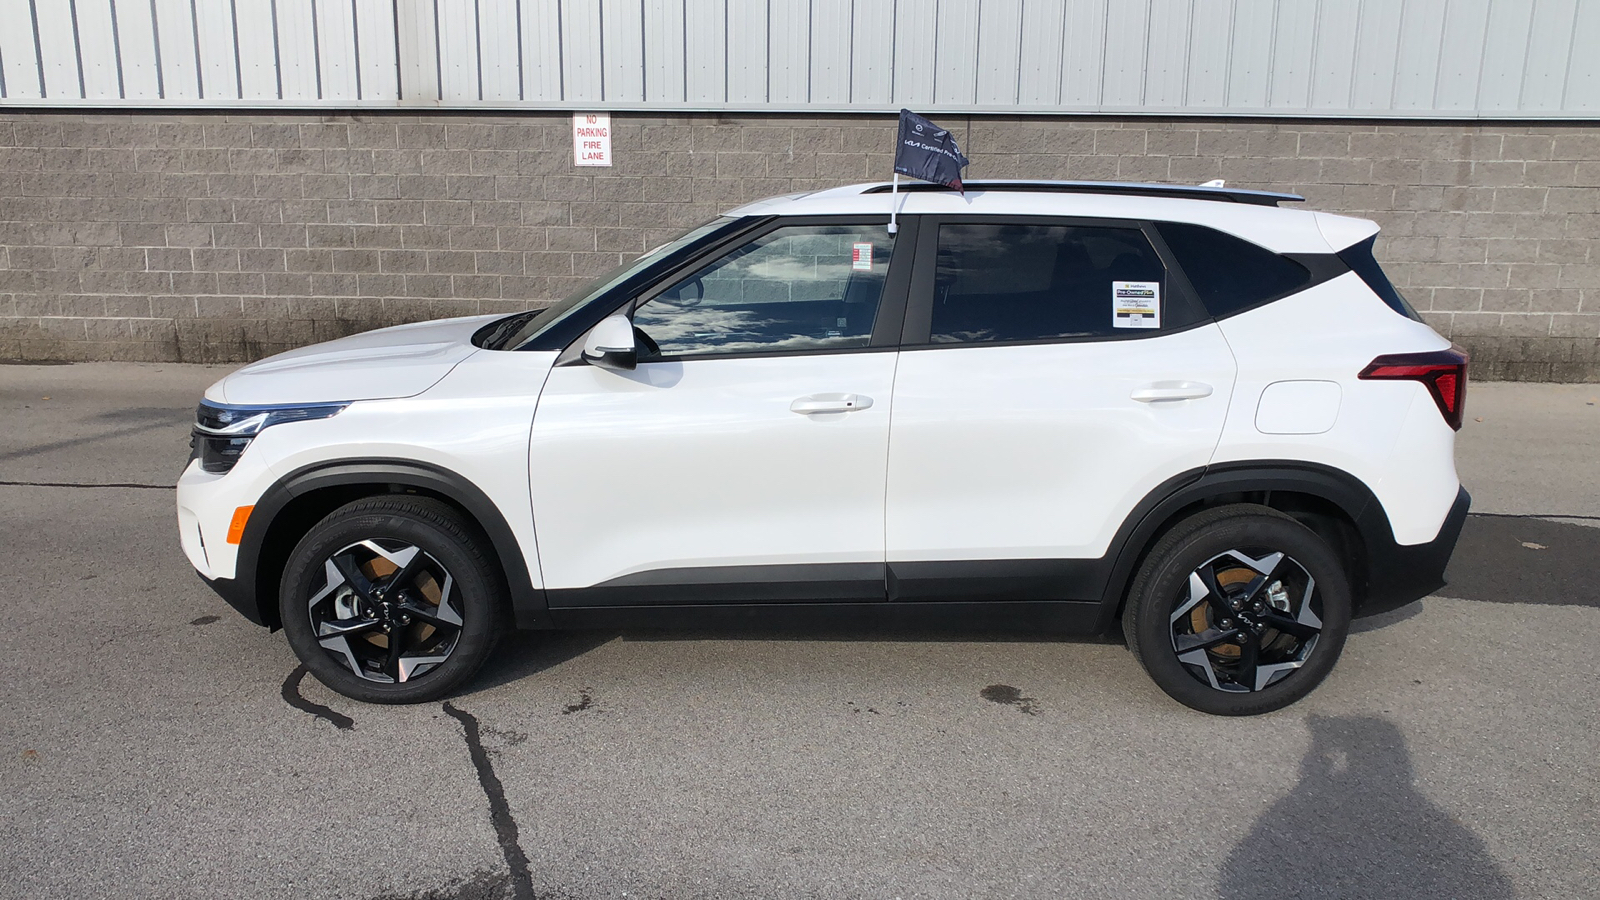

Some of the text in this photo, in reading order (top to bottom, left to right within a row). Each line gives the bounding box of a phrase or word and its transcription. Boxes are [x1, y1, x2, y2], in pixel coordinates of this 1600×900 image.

[586, 114, 597, 124] NO
[577, 127, 607, 137] PARKING
[583, 141, 602, 149] FIRE
[904, 139, 920, 148] KIA
[921, 143, 944, 154] Certified
[581, 152, 604, 160] LANE
